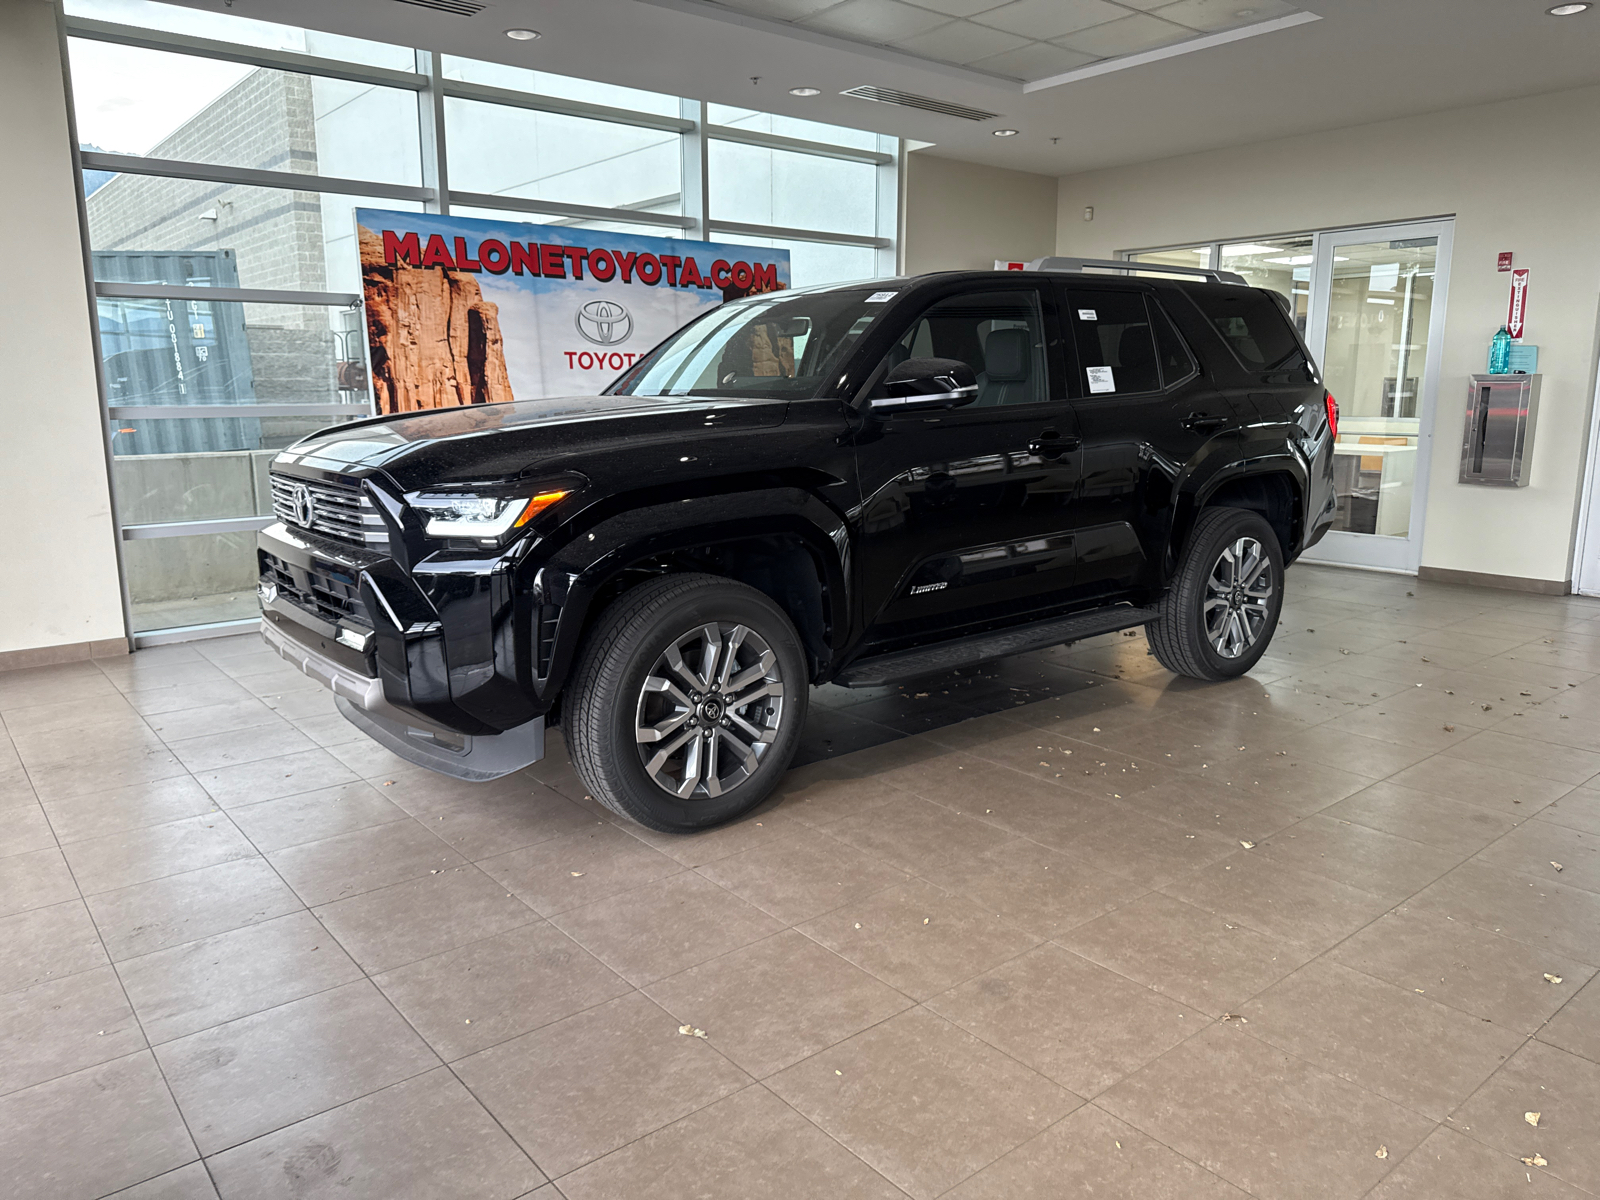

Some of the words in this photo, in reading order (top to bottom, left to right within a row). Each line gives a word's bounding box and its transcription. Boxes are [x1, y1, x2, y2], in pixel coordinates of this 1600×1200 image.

[382, 230, 778, 290] MALONETOYOTA.COM
[1512, 282, 1522, 332] EXTINGUISHER
[564, 351, 645, 370] TOYOT
